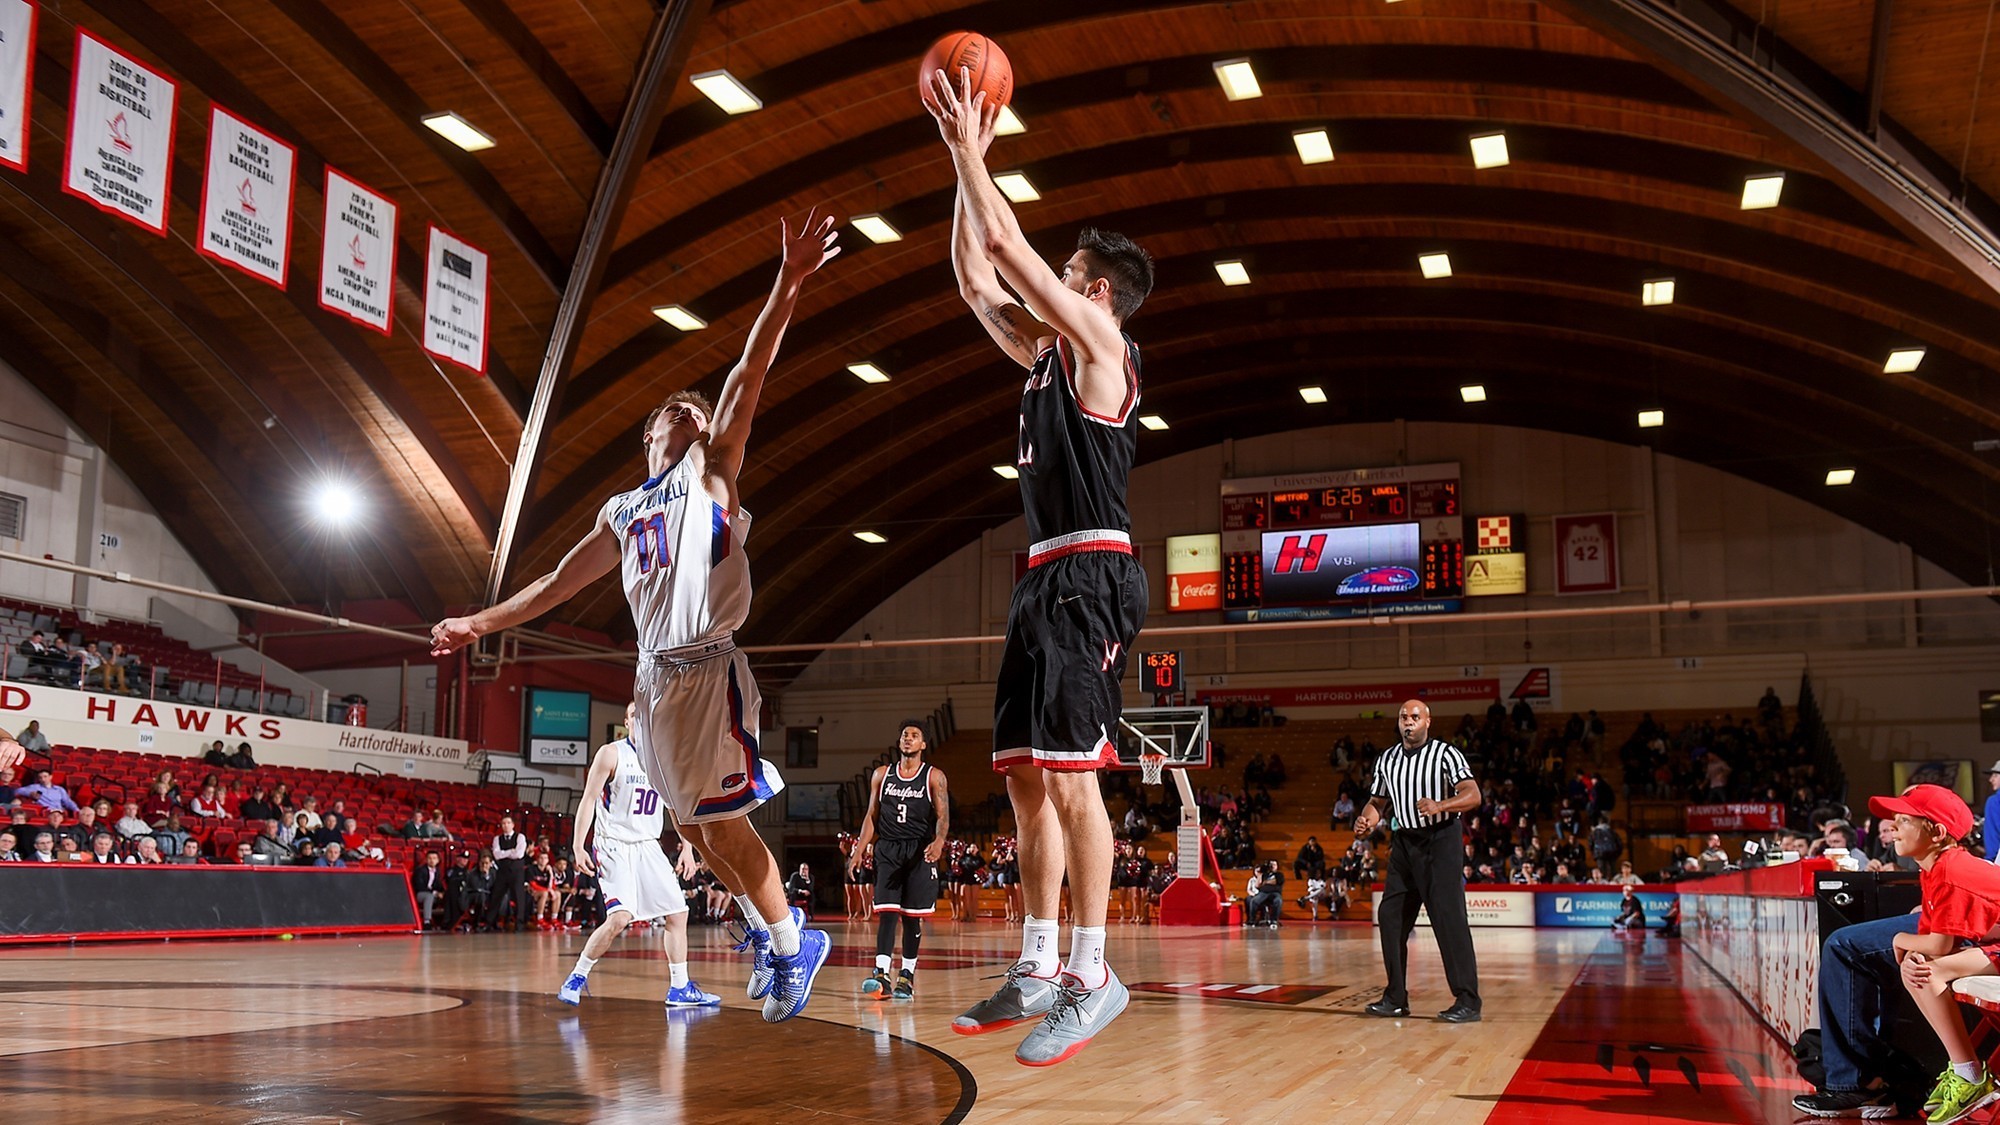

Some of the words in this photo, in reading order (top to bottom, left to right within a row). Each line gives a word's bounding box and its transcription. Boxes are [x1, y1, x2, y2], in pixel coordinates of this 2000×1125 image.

[128, 161, 145, 177] EAST
[228, 153, 274, 185] BASKETBALL
[103, 178, 153, 207] TOURNAMENT
[1322, 487, 1363, 507] 16:26
[1445, 483, 1455, 495] 4
[1255, 496, 1264, 508] 4
[1389, 497, 1403, 515] 10
[1445, 499, 1455, 514] 2
[1255, 513, 1264, 527] 2
[1289, 505, 1301, 520] 4
[100, 533, 118, 548] 210
[627, 512, 671, 575] 11
[1574, 546, 1598, 561] 42
[1148, 654, 1176, 666] 16:26
[1156, 667, 1173, 687] 10
[1295, 690, 1352, 701] HARTFORD
[1354, 689, 1393, 700] HAWKS
[87, 697, 281, 740] HAWKS
[339, 731, 460, 759] HartfordHawks.com
[626, 775, 646, 785] UMASS
[885, 783, 925, 801] Hartford
[633, 788, 659, 815] 30
[897, 803, 907, 823] 3
